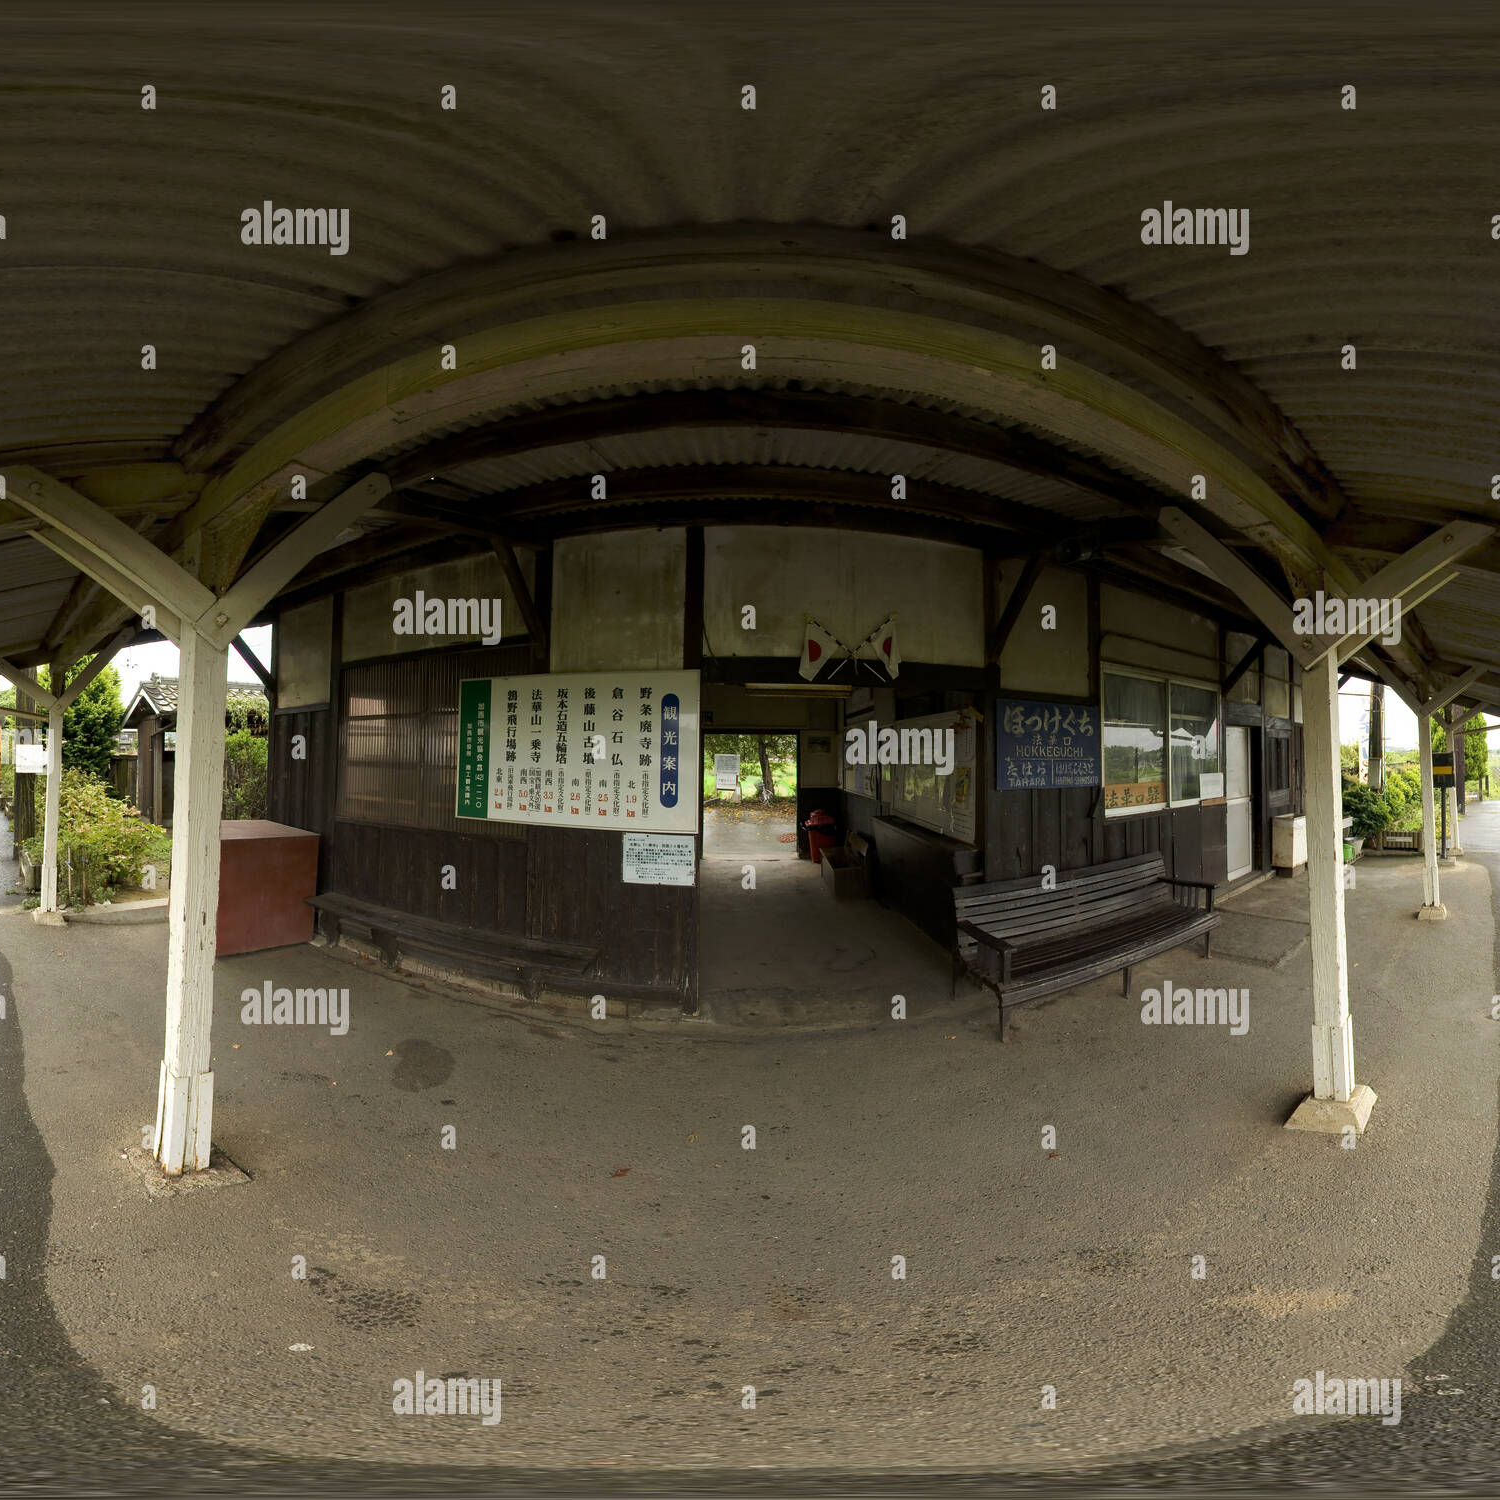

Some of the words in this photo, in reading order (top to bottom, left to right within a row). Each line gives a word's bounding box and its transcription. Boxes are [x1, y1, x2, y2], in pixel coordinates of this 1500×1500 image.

[530, 689, 542, 763] 法華山一乗寺
[556, 688, 568, 764] 坂本石造五輪塔
[583, 687, 596, 765] 後藤山古墳
[611, 687, 624, 766] 倉谷石仏
[639, 687, 652, 766] 野条廃寺跡
[662, 706, 678, 796] 観光案内
[1016, 746, 1083, 757] HOKKEGUCHI
[520, 768, 528, 785] 南西
[1007, 761, 1046, 776] たはら
[545, 769, 553, 786] 南西
[571, 778, 580, 787] 南
[599, 779, 607, 788] 南
[627, 780, 636, 789] 北
[1008, 777, 1046, 787] TAHARA
[598, 793, 609, 802] 2.5
[625, 795, 637, 803] 1.9
